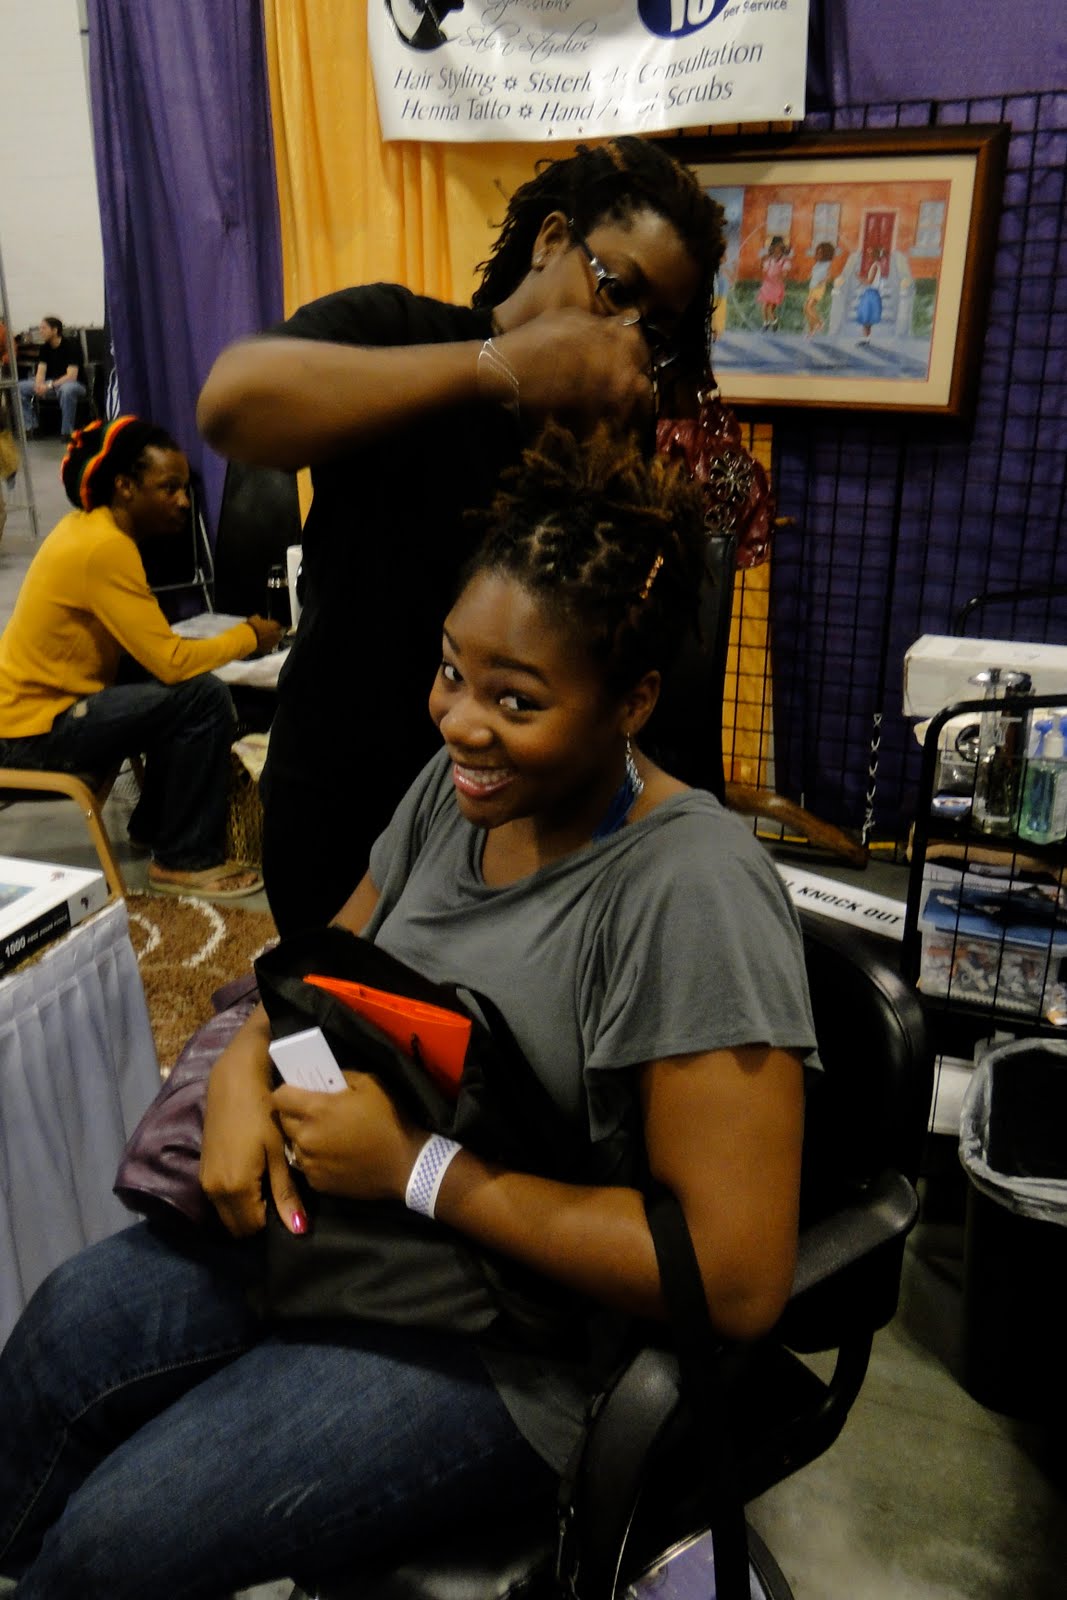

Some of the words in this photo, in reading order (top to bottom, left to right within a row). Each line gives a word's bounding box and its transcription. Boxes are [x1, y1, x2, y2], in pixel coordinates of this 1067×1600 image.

[723, 5, 740, 21] per
[393, 66, 434, 91] Hair
[437, 65, 497, 98] Styling
[637, 40, 764, 84] Consultation
[401, 98, 460, 121] Henna
[539, 97, 596, 122] Hand
[665, 74, 735, 110] Scrubs
[796, 885, 862, 912] KNOCK
[863, 907, 904, 924] OUT
[5, 934, 26, 958] 1000
